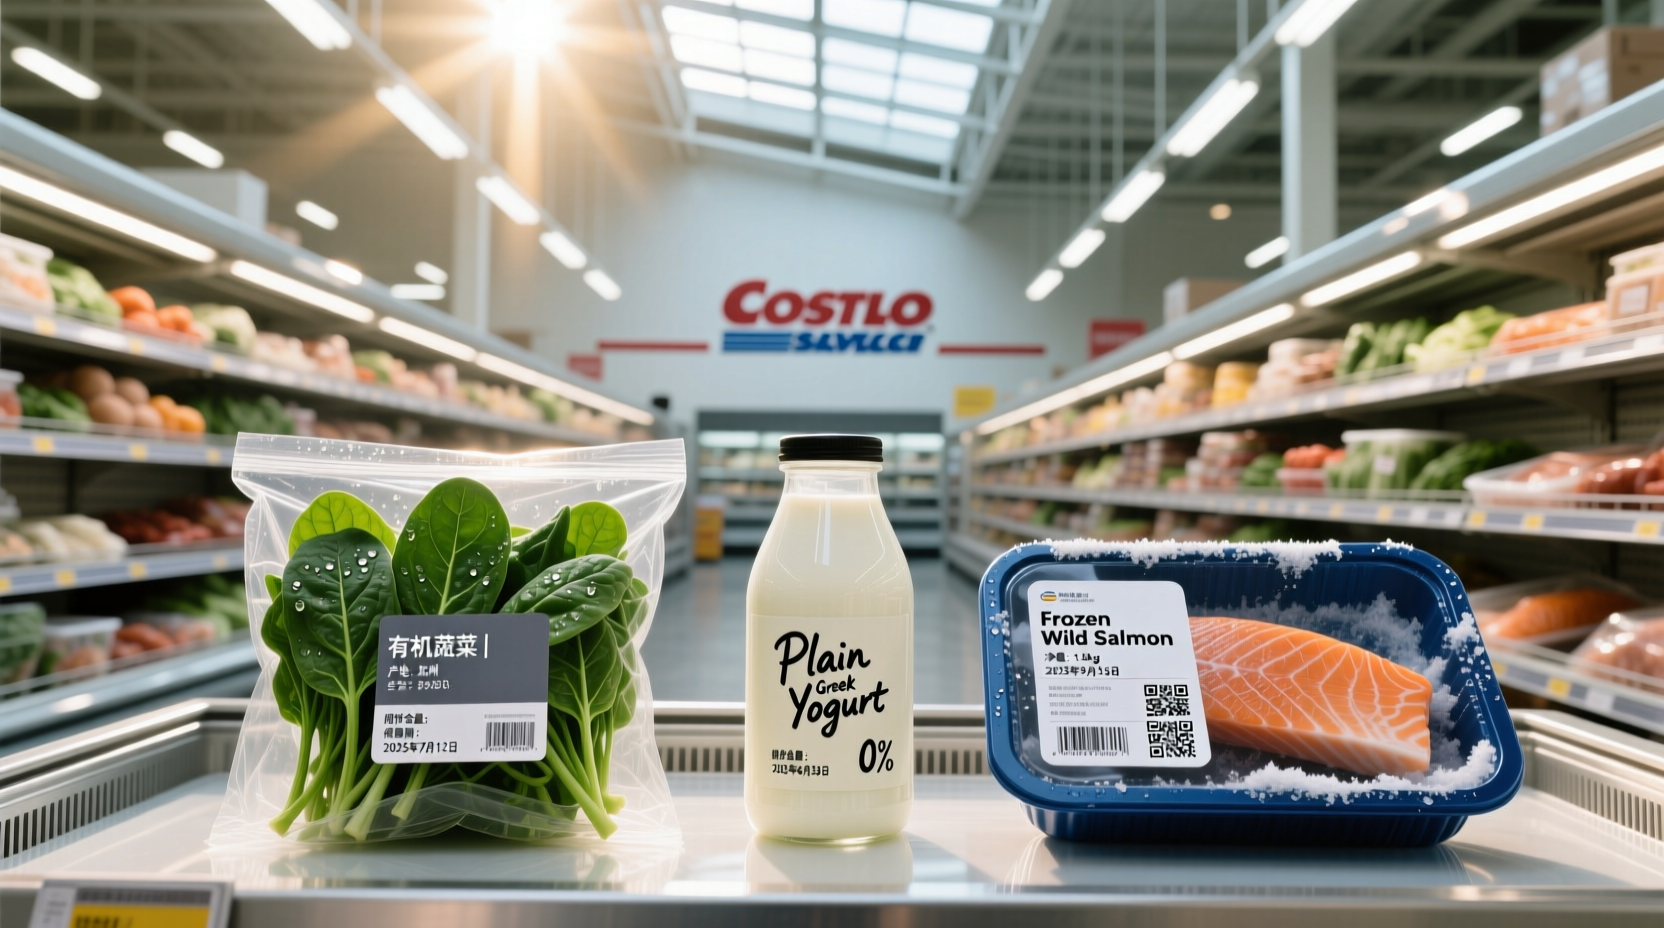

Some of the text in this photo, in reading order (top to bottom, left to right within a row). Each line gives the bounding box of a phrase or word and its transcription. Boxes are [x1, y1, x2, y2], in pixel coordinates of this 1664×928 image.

[1040, 611, 1111, 626] Frozen
[1040, 629, 1174, 646] Wild Salmon
[774, 631, 871, 686] Plain
[816, 674, 856, 695] Greek
[788, 681, 889, 738] Yogurt
[859, 738, 894, 773] 0%
